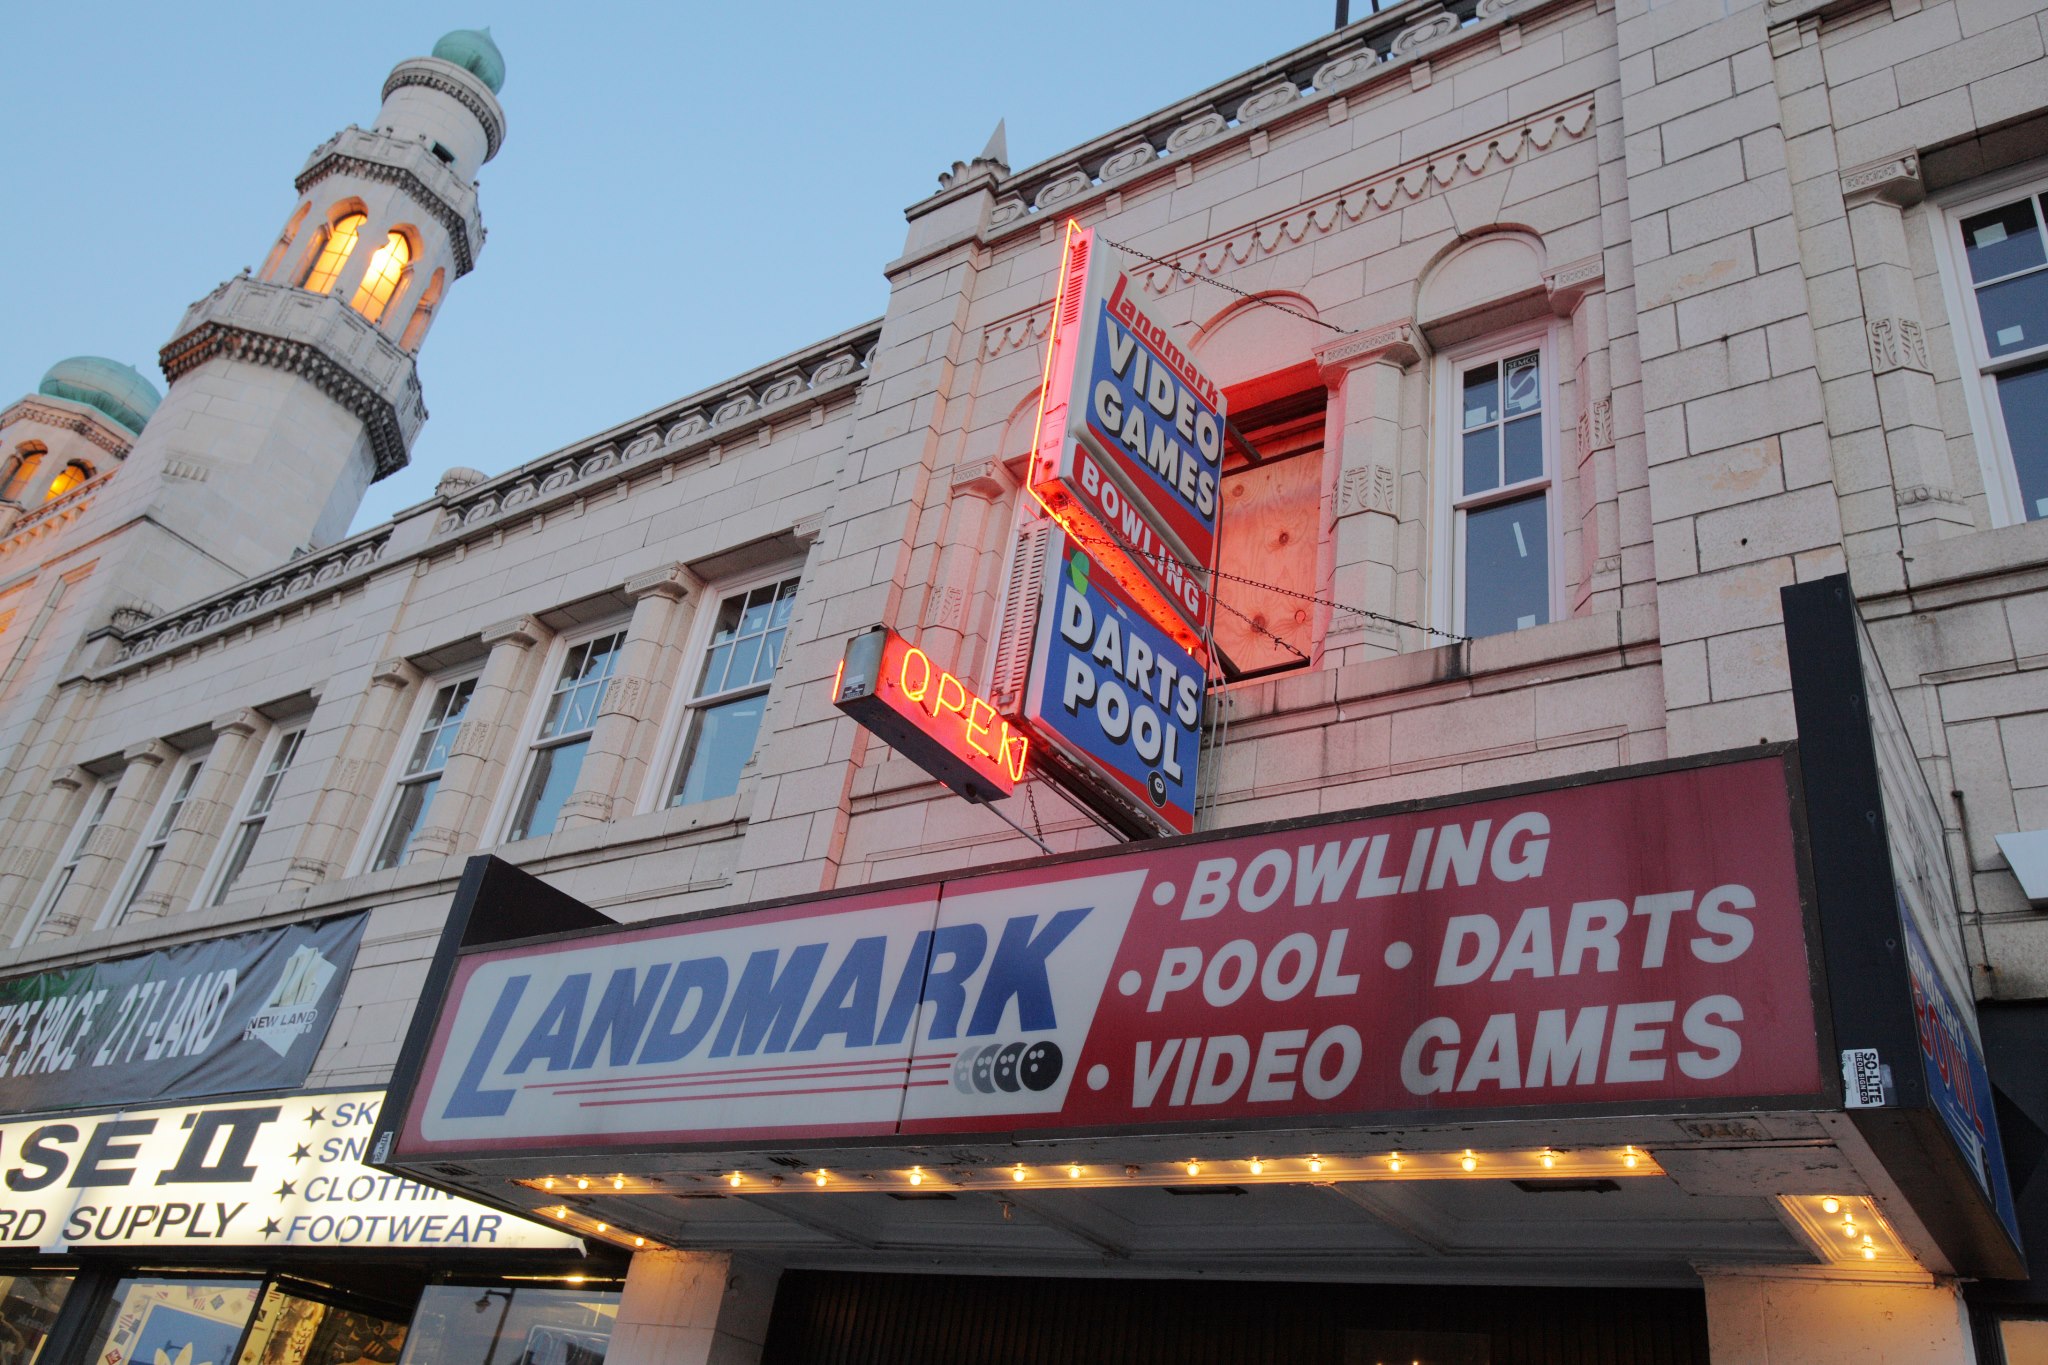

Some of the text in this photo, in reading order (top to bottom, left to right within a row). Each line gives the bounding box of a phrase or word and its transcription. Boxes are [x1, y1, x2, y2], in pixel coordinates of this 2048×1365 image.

[1104, 315, 1221, 464] VIDEO
[1105, 270, 1221, 416] Landmark
[1508, 355, 1537, 368] SEMCO
[1093, 378, 1216, 517] GAMES
[1080, 453, 1200, 617] BOWLING
[900, 647, 1029, 782] OPEN
[1059, 582, 1199, 732] DARTS
[1063, 662, 1184, 788] POOL
[1181, 811, 1552, 921] BOWLING
[1146, 883, 1757, 1013] POOL DARTS
[1902, 920, 1967, 1061] Landmark
[12, 989, 109, 1078] SPACE
[92, 968, 238, 1067] 277-LAND
[248, 1010, 317, 1029] NEW LAND
[442, 906, 1096, 1119] LANDMARK
[1131, 1024, 1364, 1109] VIDEO
[1398, 994, 1746, 1096] GAMES
[1909, 968, 1986, 1140] BOWL
[1855, 1052, 1869, 1104] NEON SIGN CO.
[1864, 1053, 1882, 1103] SO-LITE
[62, 1201, 249, 1241] SUPPLY
[285, 1214, 503, 1243] FOOTWEAR
